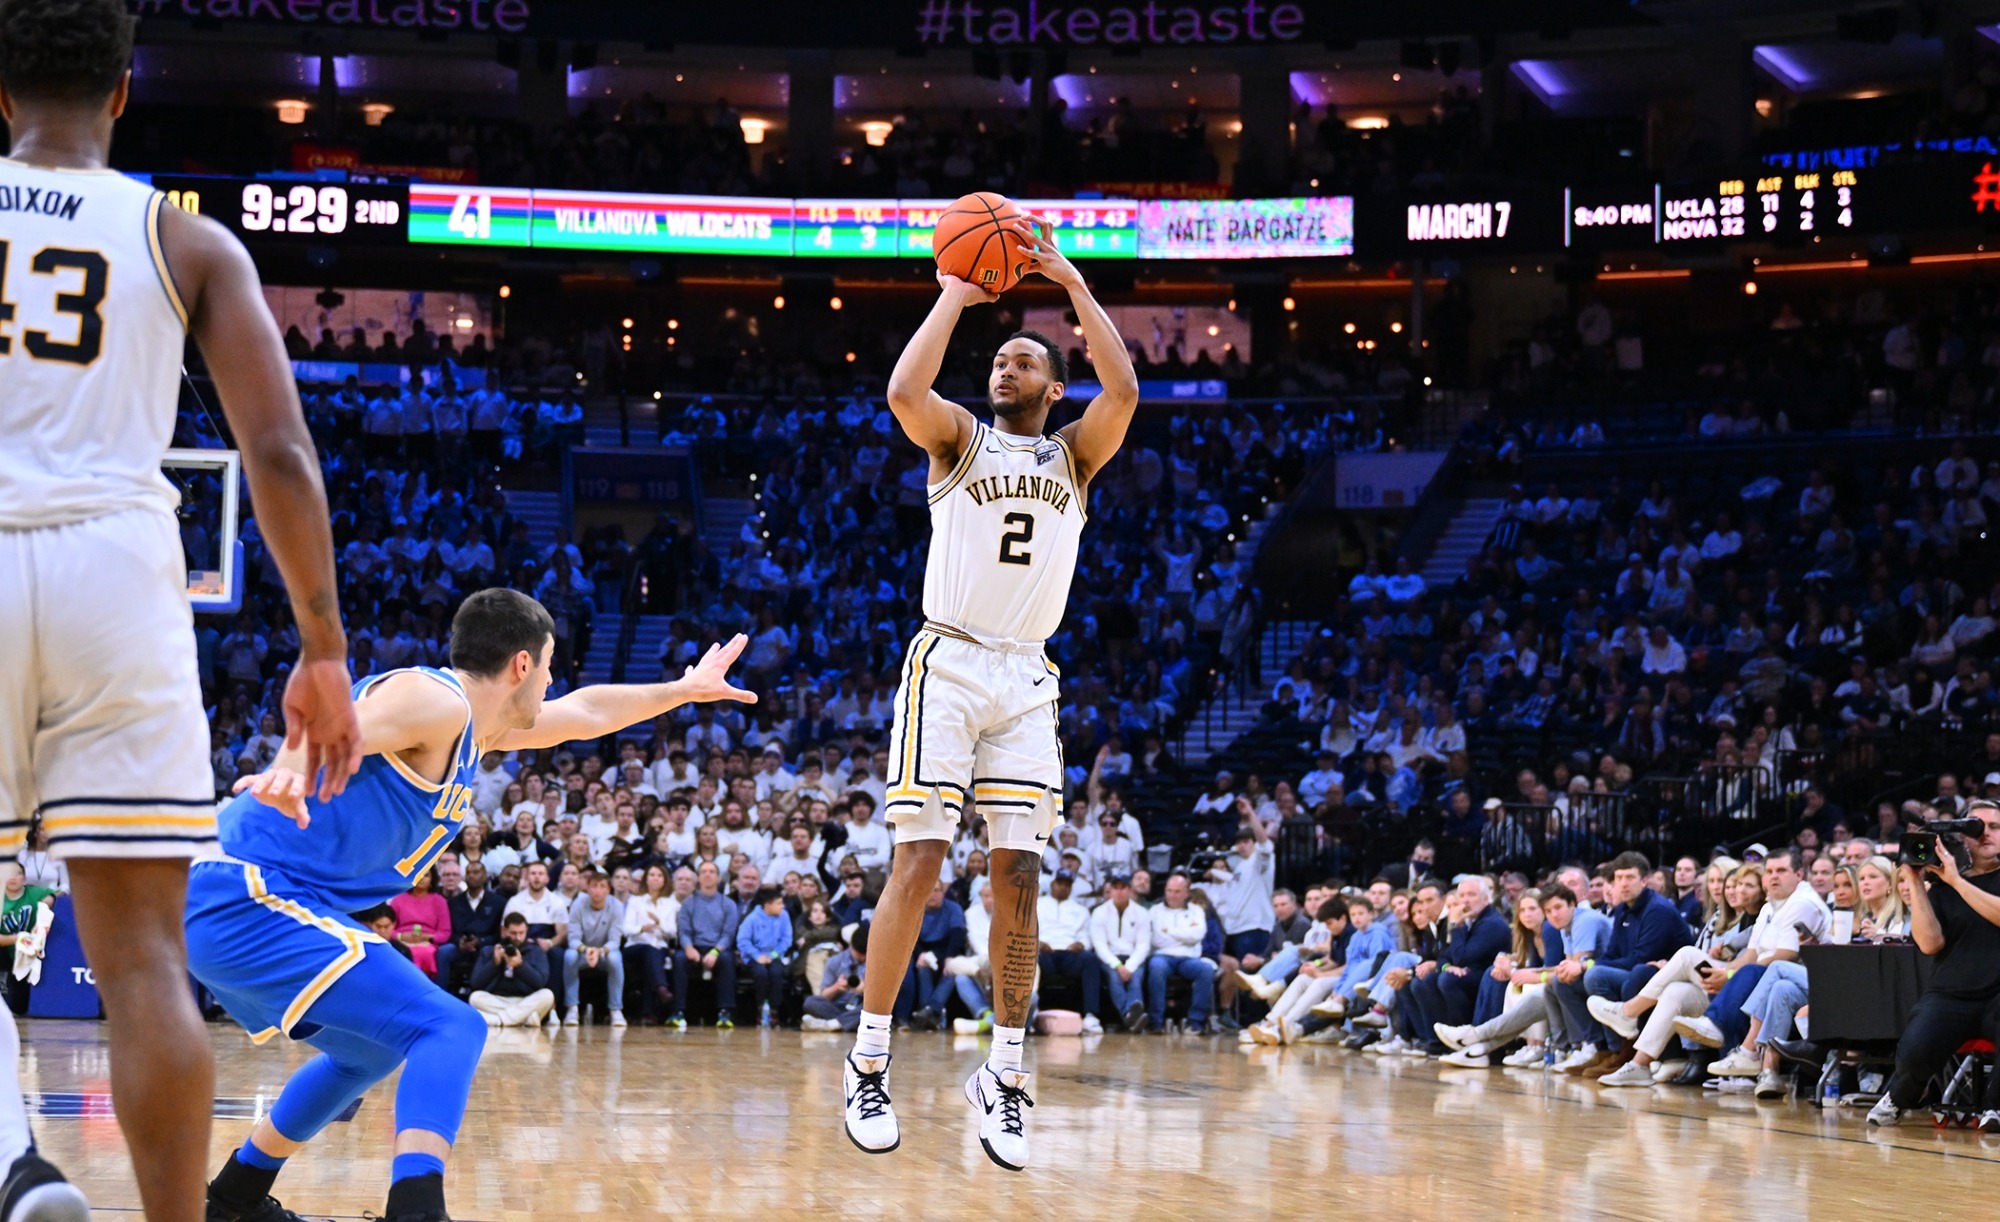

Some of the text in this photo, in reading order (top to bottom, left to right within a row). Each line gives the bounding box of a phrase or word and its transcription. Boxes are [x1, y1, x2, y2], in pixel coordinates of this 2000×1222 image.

[137, 0, 530, 33] aeaaste
[916, 0, 1304, 44] #takeataste
[1756, 176, 1783, 193] AST
[1832, 170, 1858, 187] STL
[0, 185, 85, 222] DIXON
[242, 184, 348, 233] 9:29
[355, 200, 399, 224] 2ND
[448, 194, 491, 238] 41
[907, 209, 944, 228] PLA
[1072, 210, 1096, 228] 23
[1103, 210, 1128, 228] 43
[1574, 204, 1652, 226] 8:40 PM
[1665, 197, 1716, 220] UCLA
[1761, 193, 1779, 213] 11
[1800, 190, 1815, 209] 4
[1837, 187, 1851, 207] 3
[555, 207, 772, 240] VILLANOVA WILDCATS
[814, 225, 877, 249] 4 3
[1168, 211, 1327, 243] NATE BARGATZE
[1408, 201, 1512, 240] MARCH 7
[1663, 207, 1852, 240] NOVA 32 9 2 4
[0, 237, 111, 368] 3
[965, 474, 1071, 515] VILLANOVA
[998, 511, 1035, 566] 2
[394, 824, 452, 887] 1
